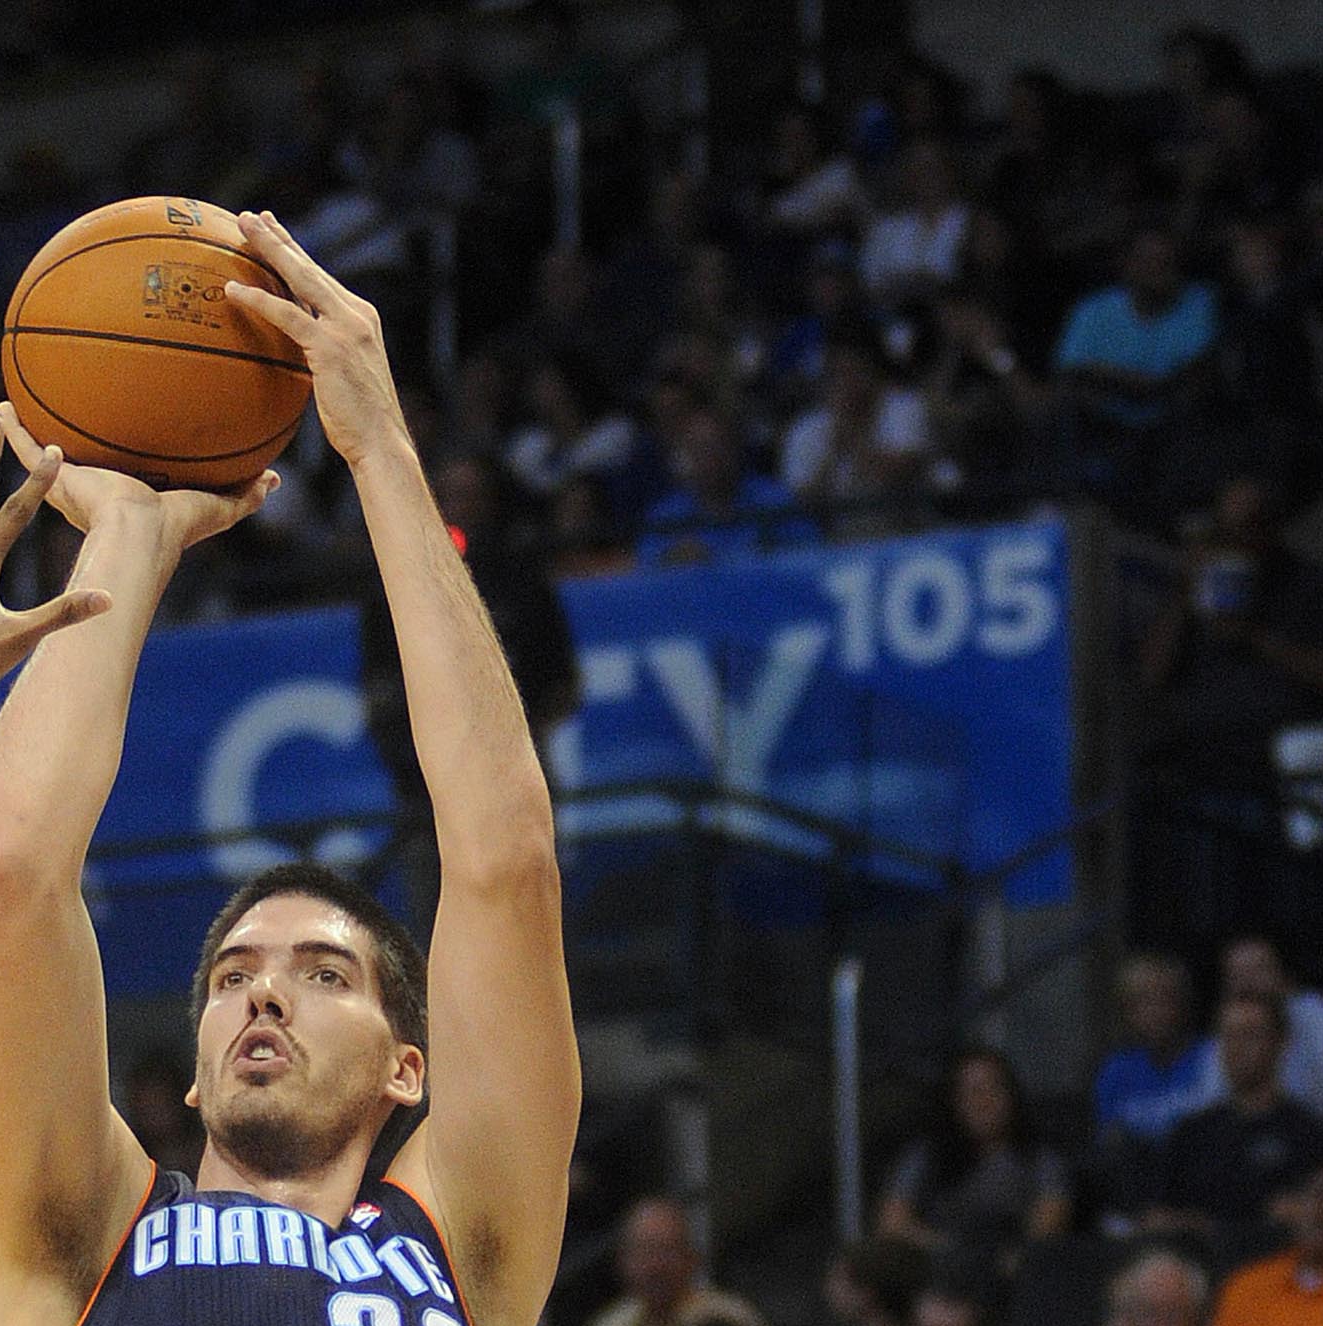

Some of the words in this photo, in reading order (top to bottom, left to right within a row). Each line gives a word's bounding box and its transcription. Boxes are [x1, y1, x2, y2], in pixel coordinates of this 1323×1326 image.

[826, 536, 1060, 673] 105
[198, 617, 834, 878] CTY
[133, 1203, 455, 1304] CHARLOTE
